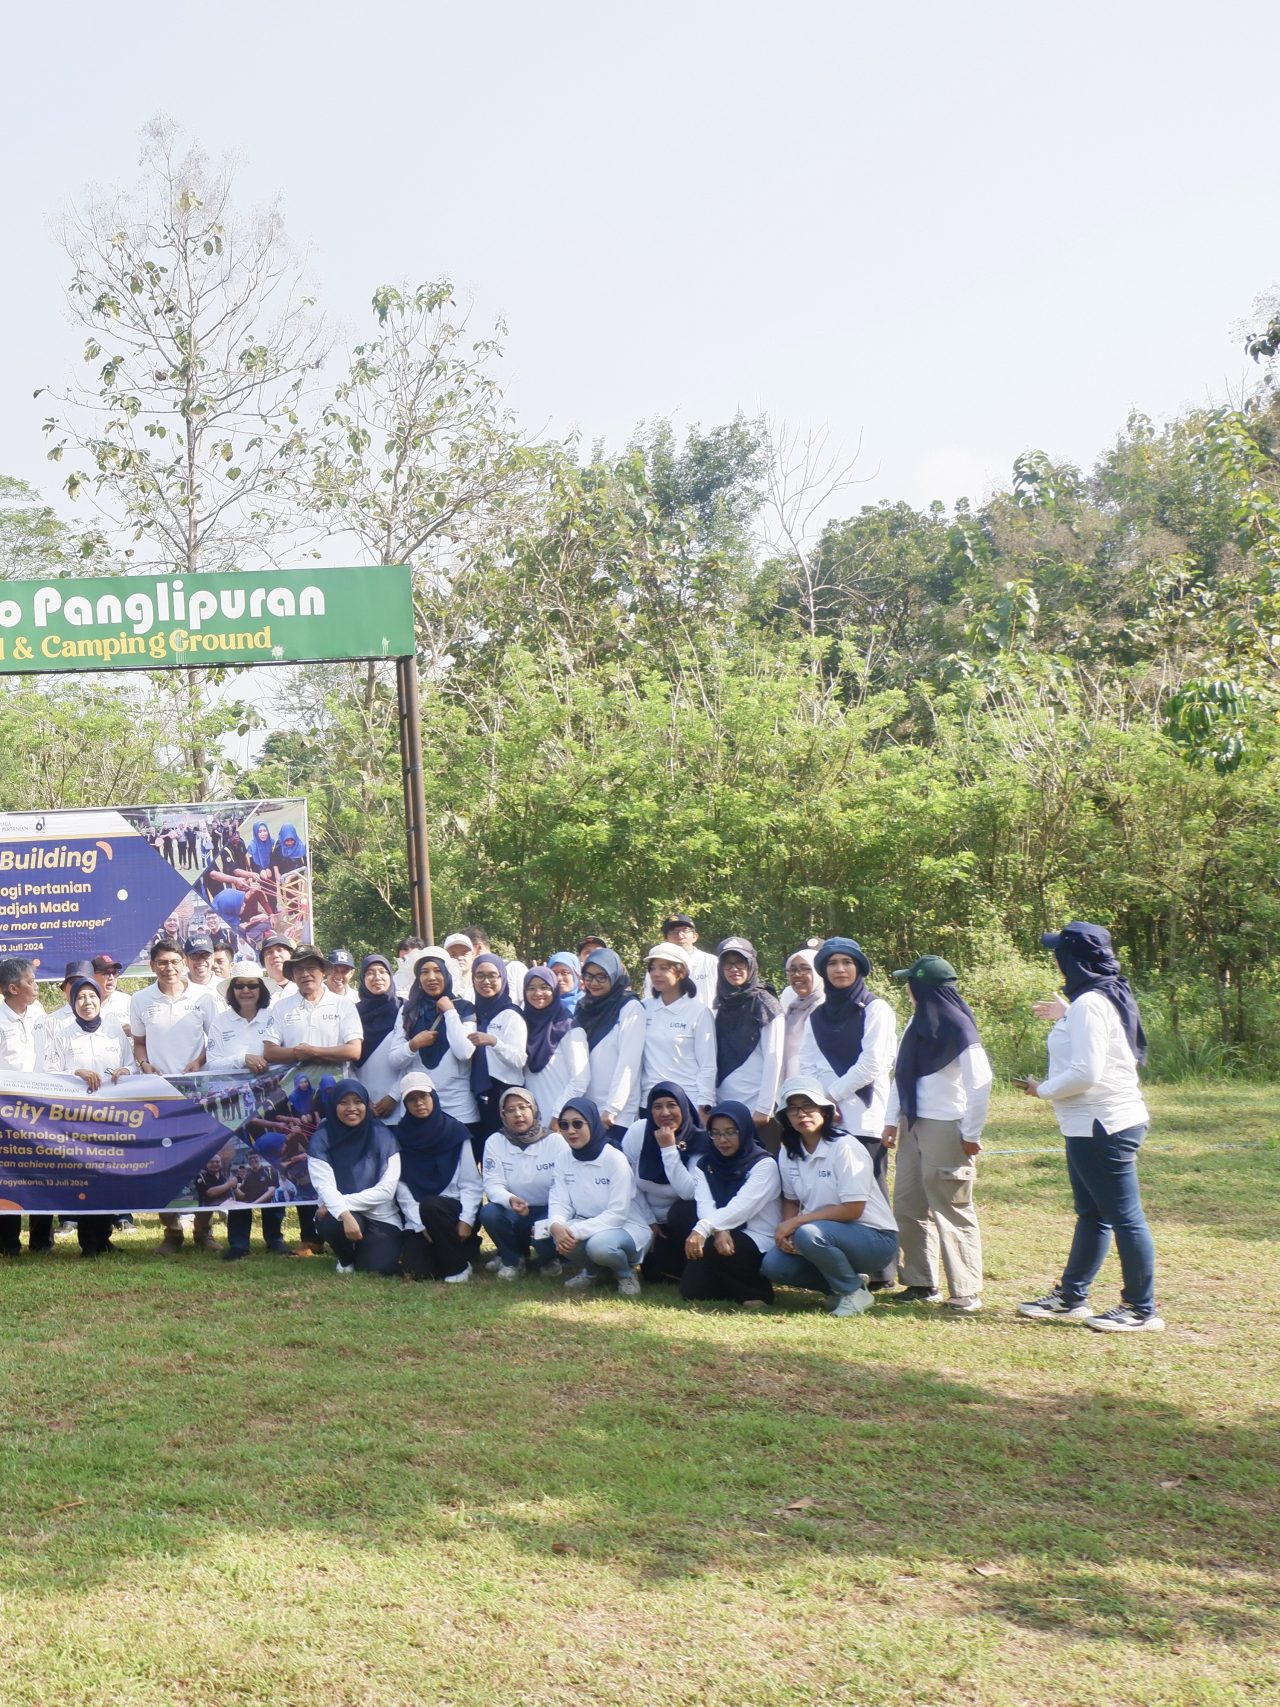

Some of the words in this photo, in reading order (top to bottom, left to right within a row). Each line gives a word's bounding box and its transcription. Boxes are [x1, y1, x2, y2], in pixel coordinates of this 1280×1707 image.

[33, 579, 326, 635] Panglipuran
[12, 636, 35, 660] &
[169, 625, 273, 652] Ground
[0, 846, 99, 874] Building
[24, 881, 92, 896] Pertanian
[40, 900, 79, 914] Mada
[10, 923, 38, 932] more
[40, 919, 61, 930] and
[62, 917, 112, 930] stronger”
[0, 944, 7, 952] 13
[8, 943, 23, 952] Juli
[23, 943, 44, 952] 2024
[191, 938, 208, 948] UGM
[322, 1014, 340, 1022] UGM
[48, 1103, 145, 1128] Building
[5, 1129, 69, 1143] Teknologi
[71, 1131, 136, 1142] Pertanian
[35, 1144, 84, 1158] Gadjah
[86, 1146, 125, 1156] Mada
[17, 1160, 55, 1169] achieve
[84, 1161, 105, 1169] and
[536, 1162, 556, 1172] UGM
[55, 1178, 69, 1186] Juli
[70, 1179, 89, 1187] 2024
